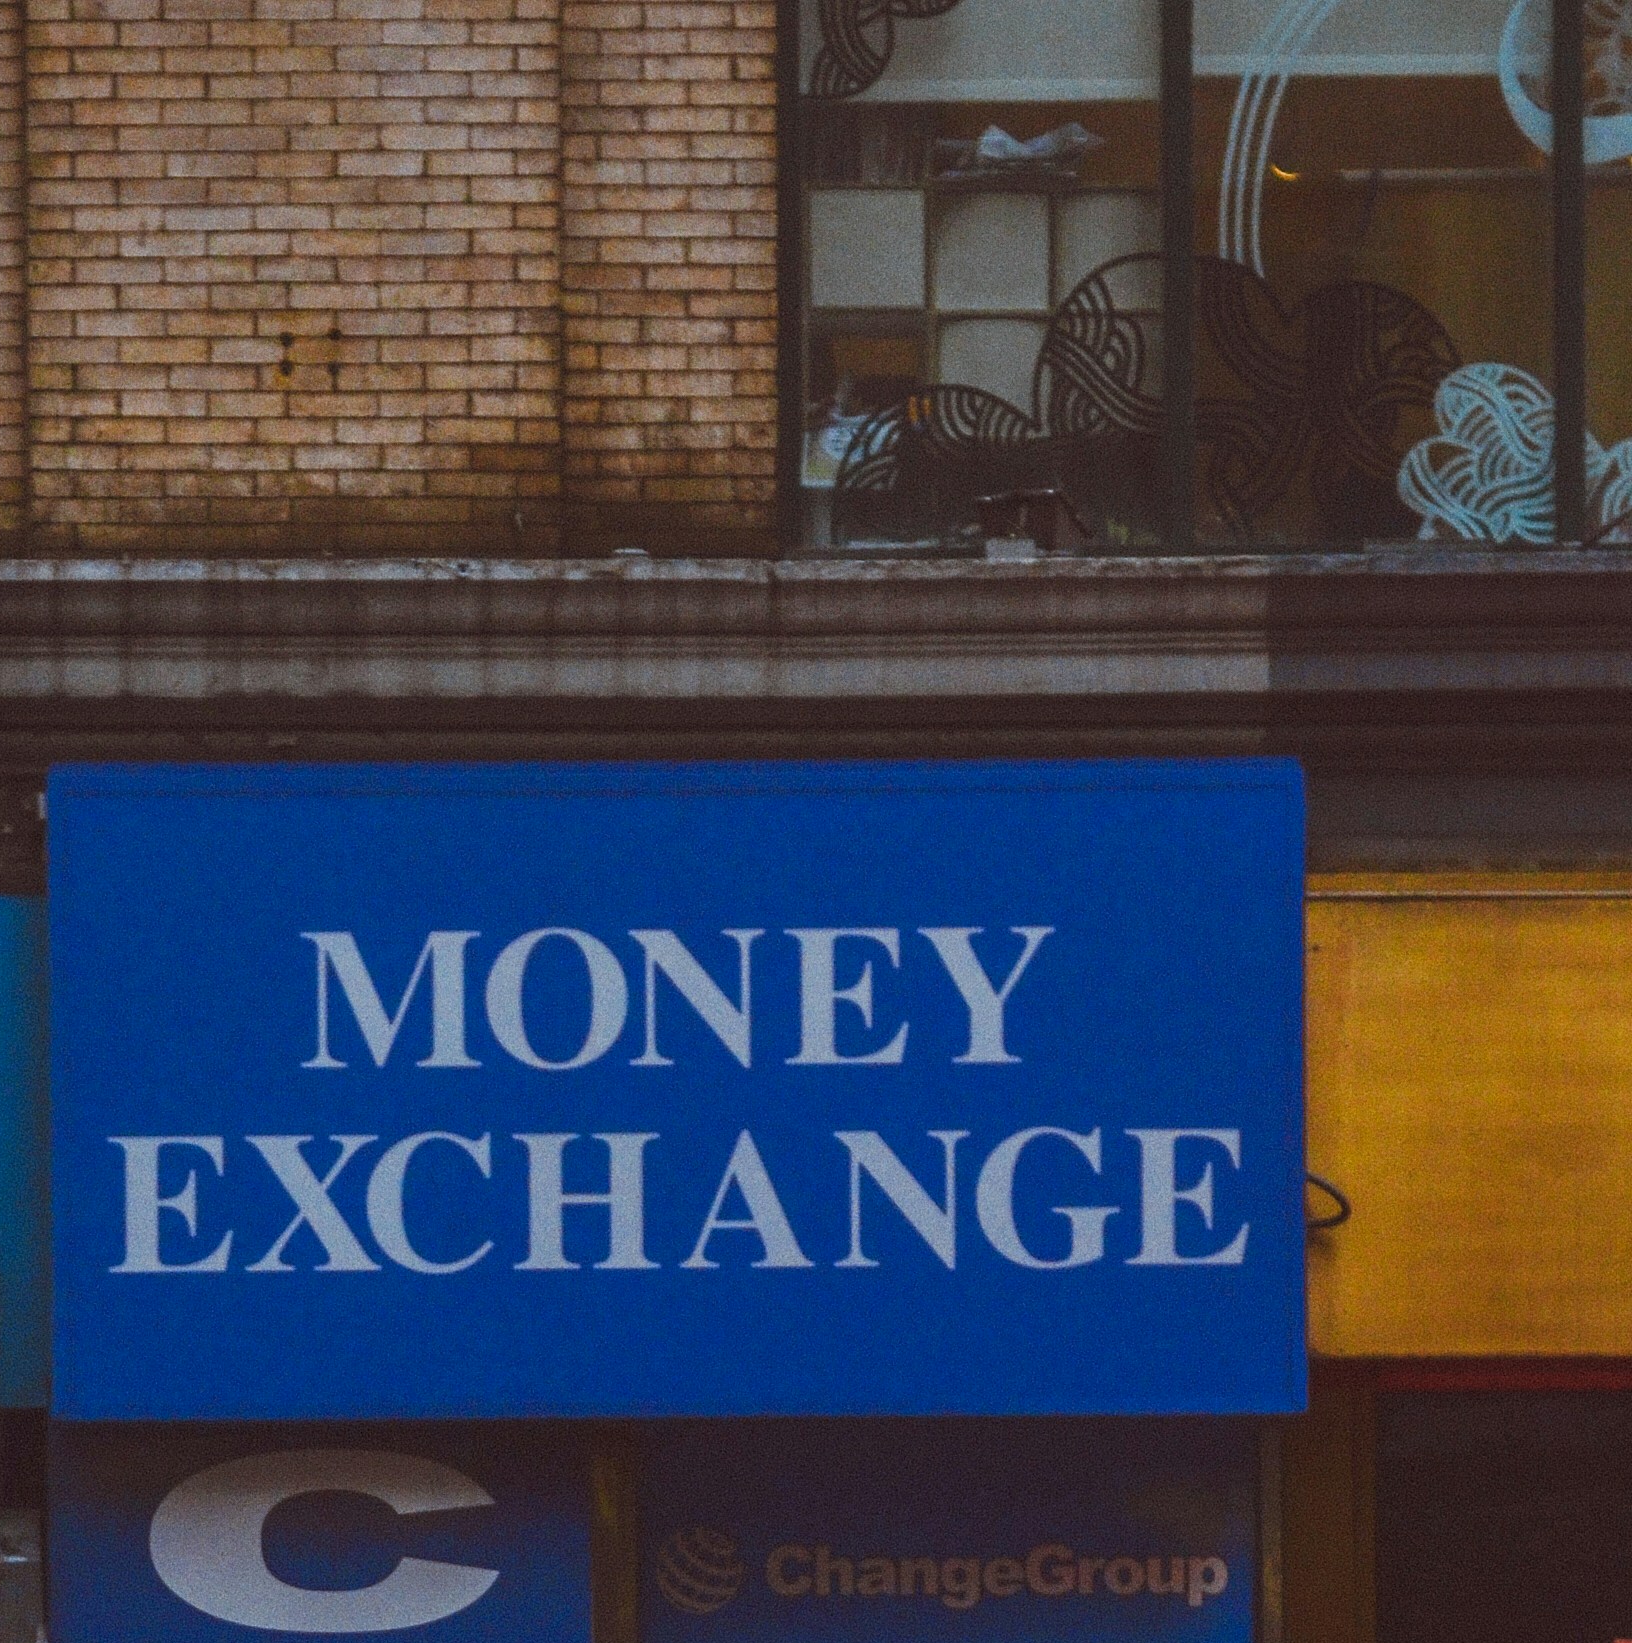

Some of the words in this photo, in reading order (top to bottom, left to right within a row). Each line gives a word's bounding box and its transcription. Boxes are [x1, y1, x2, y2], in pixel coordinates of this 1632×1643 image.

[300, 925, 1057, 1070] MONEY
[107, 1125, 1251, 1275] EXCHANGE
[766, 1544, 1230, 1608] ChangeGroup
